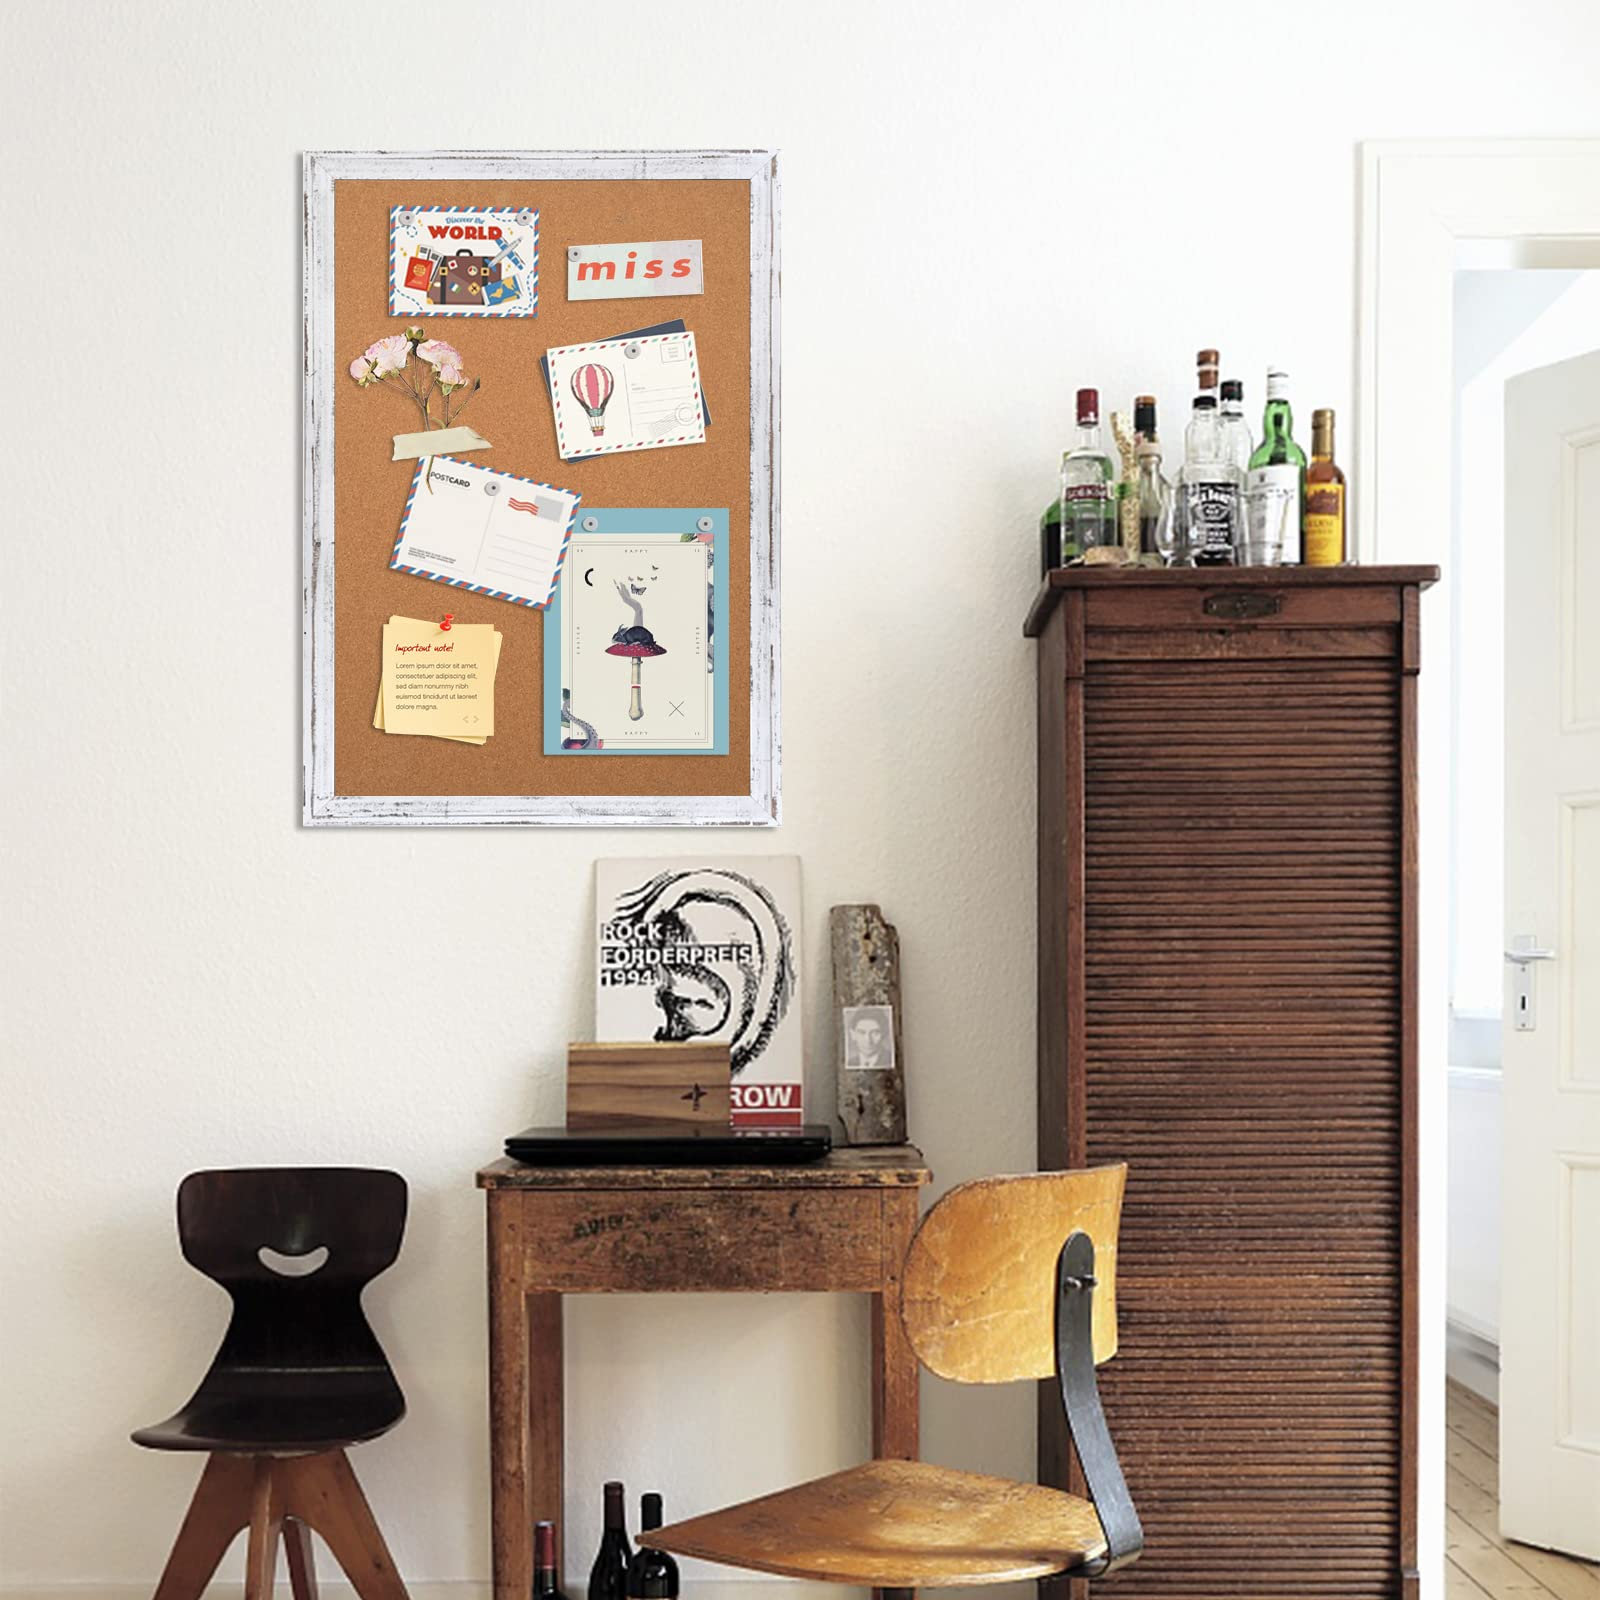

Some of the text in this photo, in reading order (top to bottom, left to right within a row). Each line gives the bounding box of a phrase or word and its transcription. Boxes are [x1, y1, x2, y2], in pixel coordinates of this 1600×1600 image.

[427, 225, 503, 240] WORLD
[577, 251, 691, 281] miss
[430, 471, 471, 488] POSTCARD
[395, 642, 454, 655] Important note!
[424, 683, 454, 691] nonummy
[602, 922, 663, 941] ROCK
[602, 970, 655, 986] 1994
[729, 1086, 792, 1107] ROW
